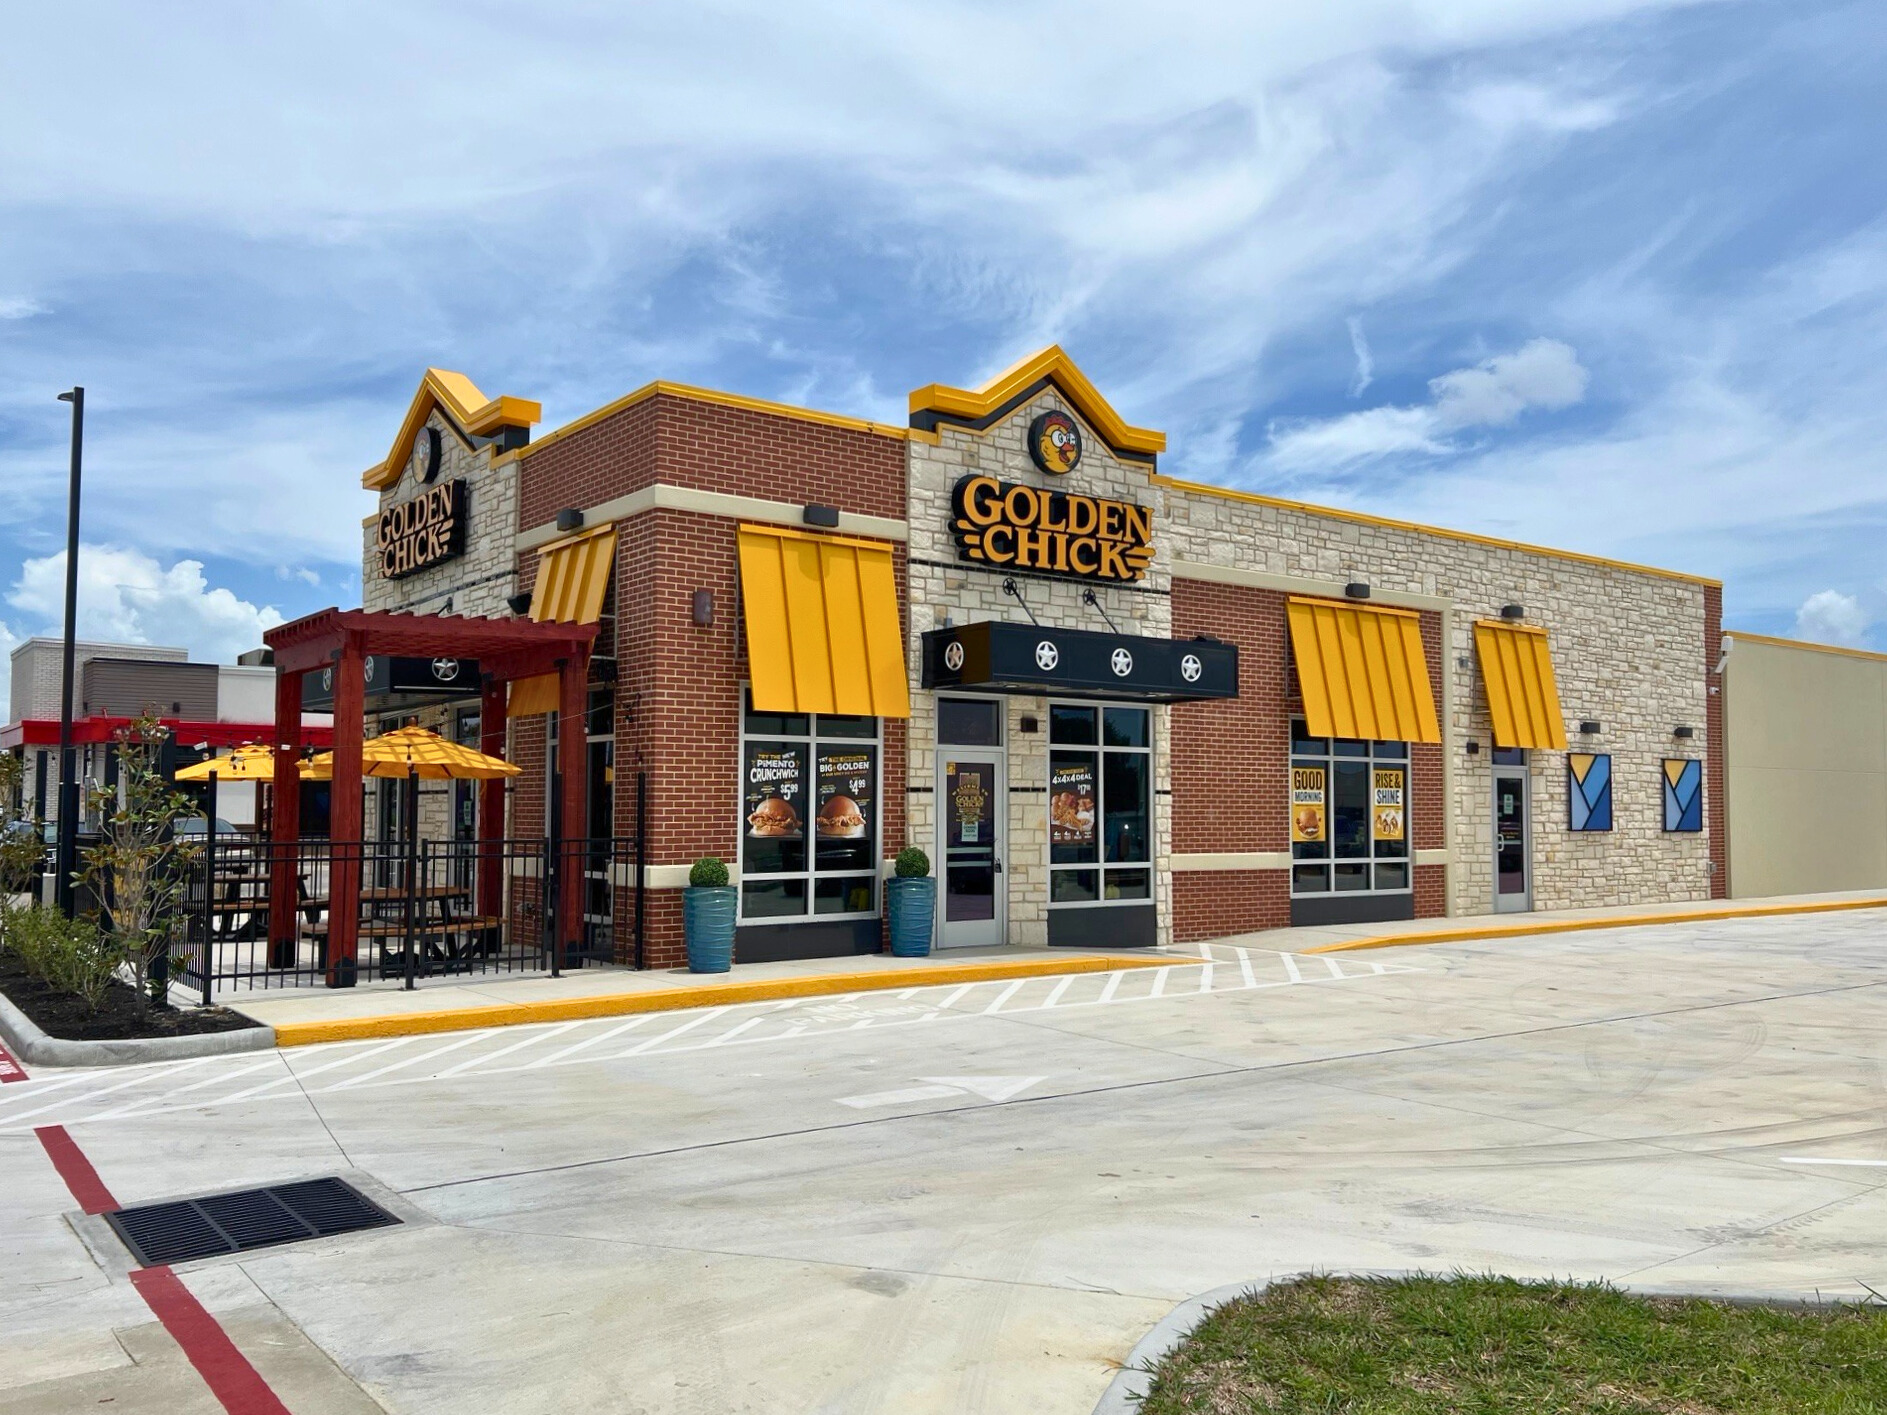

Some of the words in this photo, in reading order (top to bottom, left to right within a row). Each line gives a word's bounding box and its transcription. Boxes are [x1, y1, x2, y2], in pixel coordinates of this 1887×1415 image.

[378, 478, 455, 550] GOLDEN
[964, 476, 1154, 545] GOLDEN
[383, 522, 442, 577] CHICK
[983, 524, 1134, 580] CHICK
[750, 767, 799, 783] CRUNCHWICH
[819, 764, 833, 772] BIG
[836, 761, 870, 771] GOLDEN
[1294, 770, 1323, 790] GOOD
[1294, 791, 1322, 802] MORNING
[1376, 789, 1400, 804] SHINE
